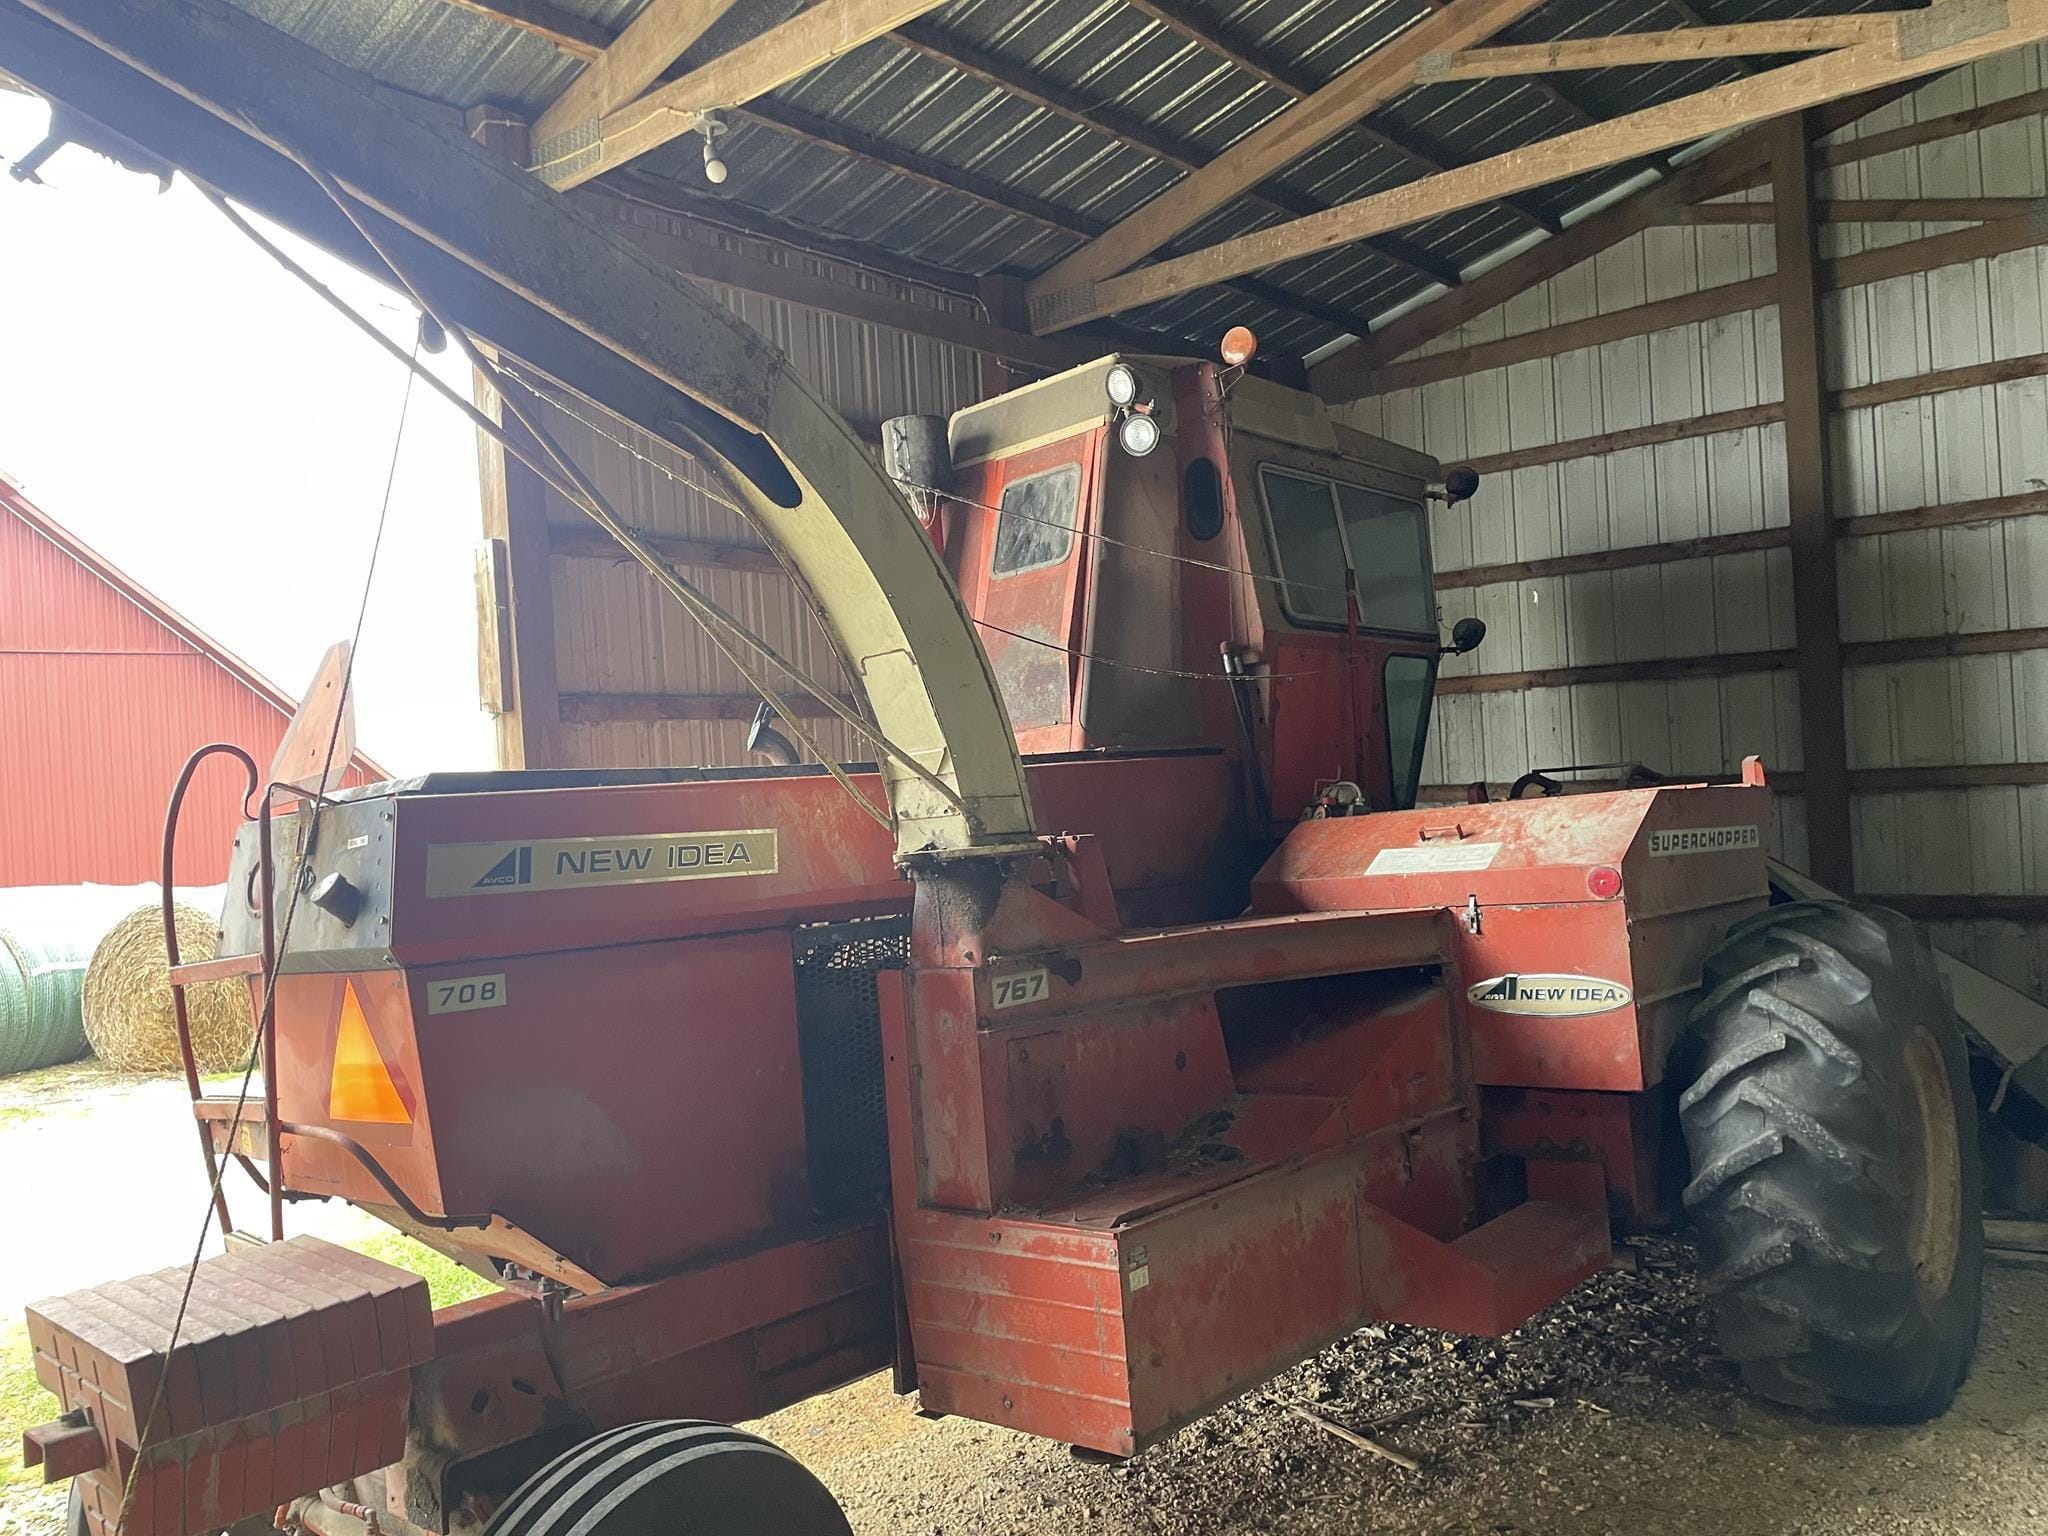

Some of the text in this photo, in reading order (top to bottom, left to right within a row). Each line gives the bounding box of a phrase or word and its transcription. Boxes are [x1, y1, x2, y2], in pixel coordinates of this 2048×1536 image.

[1651, 829, 1756, 852] SUPERCHOPPER
[555, 842, 752, 876] NEW IDEA
[438, 981, 497, 1007] 708
[996, 974, 1044, 1005] 767
[1520, 988, 1617, 1001] NEW IDEA
